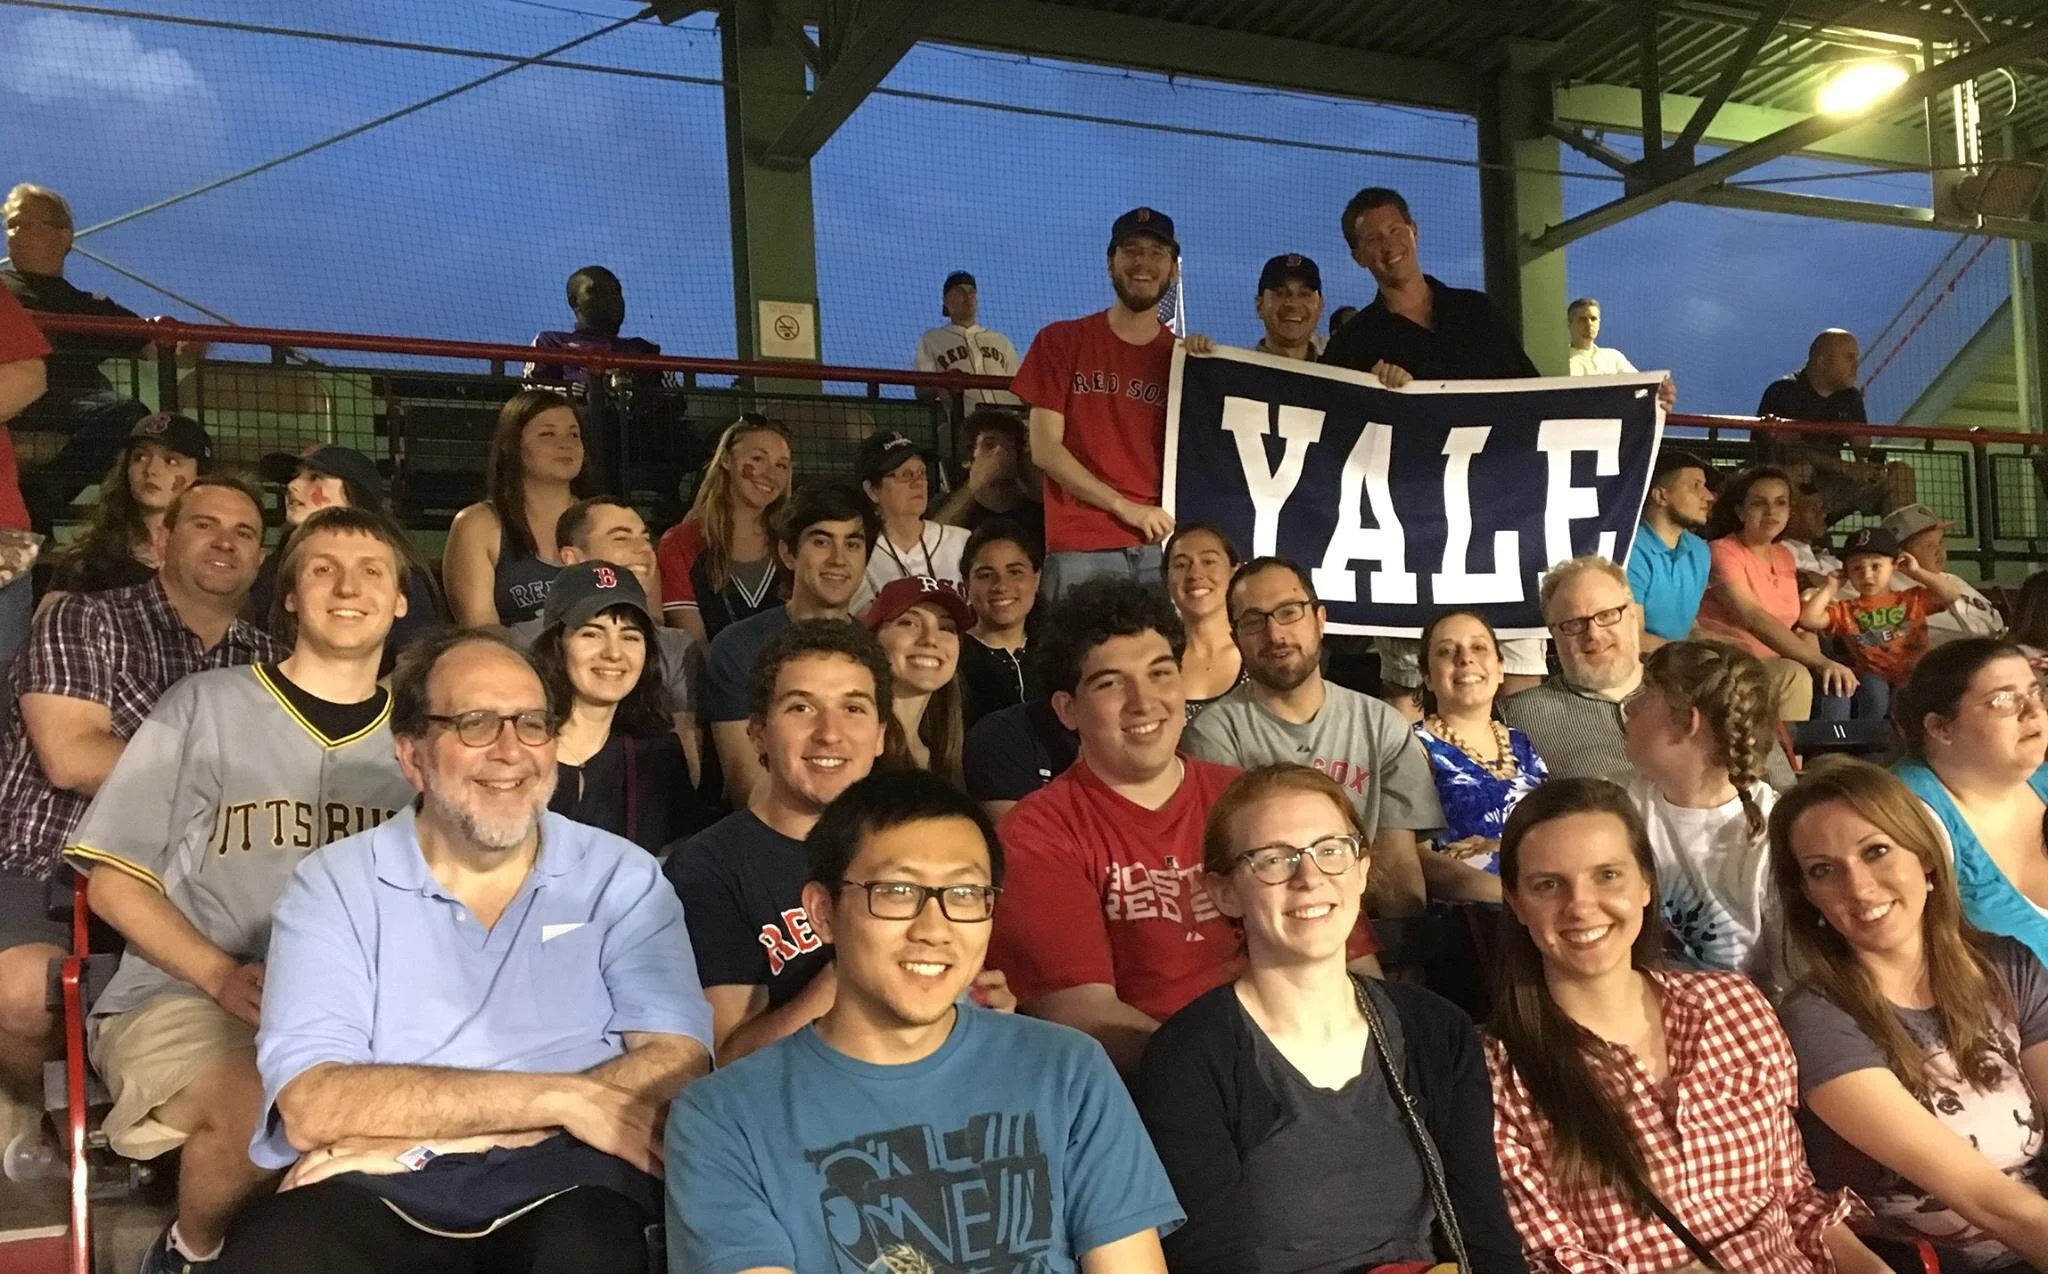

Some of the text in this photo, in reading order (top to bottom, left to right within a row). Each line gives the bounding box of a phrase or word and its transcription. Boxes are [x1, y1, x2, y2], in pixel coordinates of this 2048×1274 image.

[937, 346, 968, 370] RED
[1073, 370, 1164, 407] RED SO
[1221, 396, 1624, 605] YALE
[593, 567, 618, 589] B
[509, 580, 555, 608] RE
